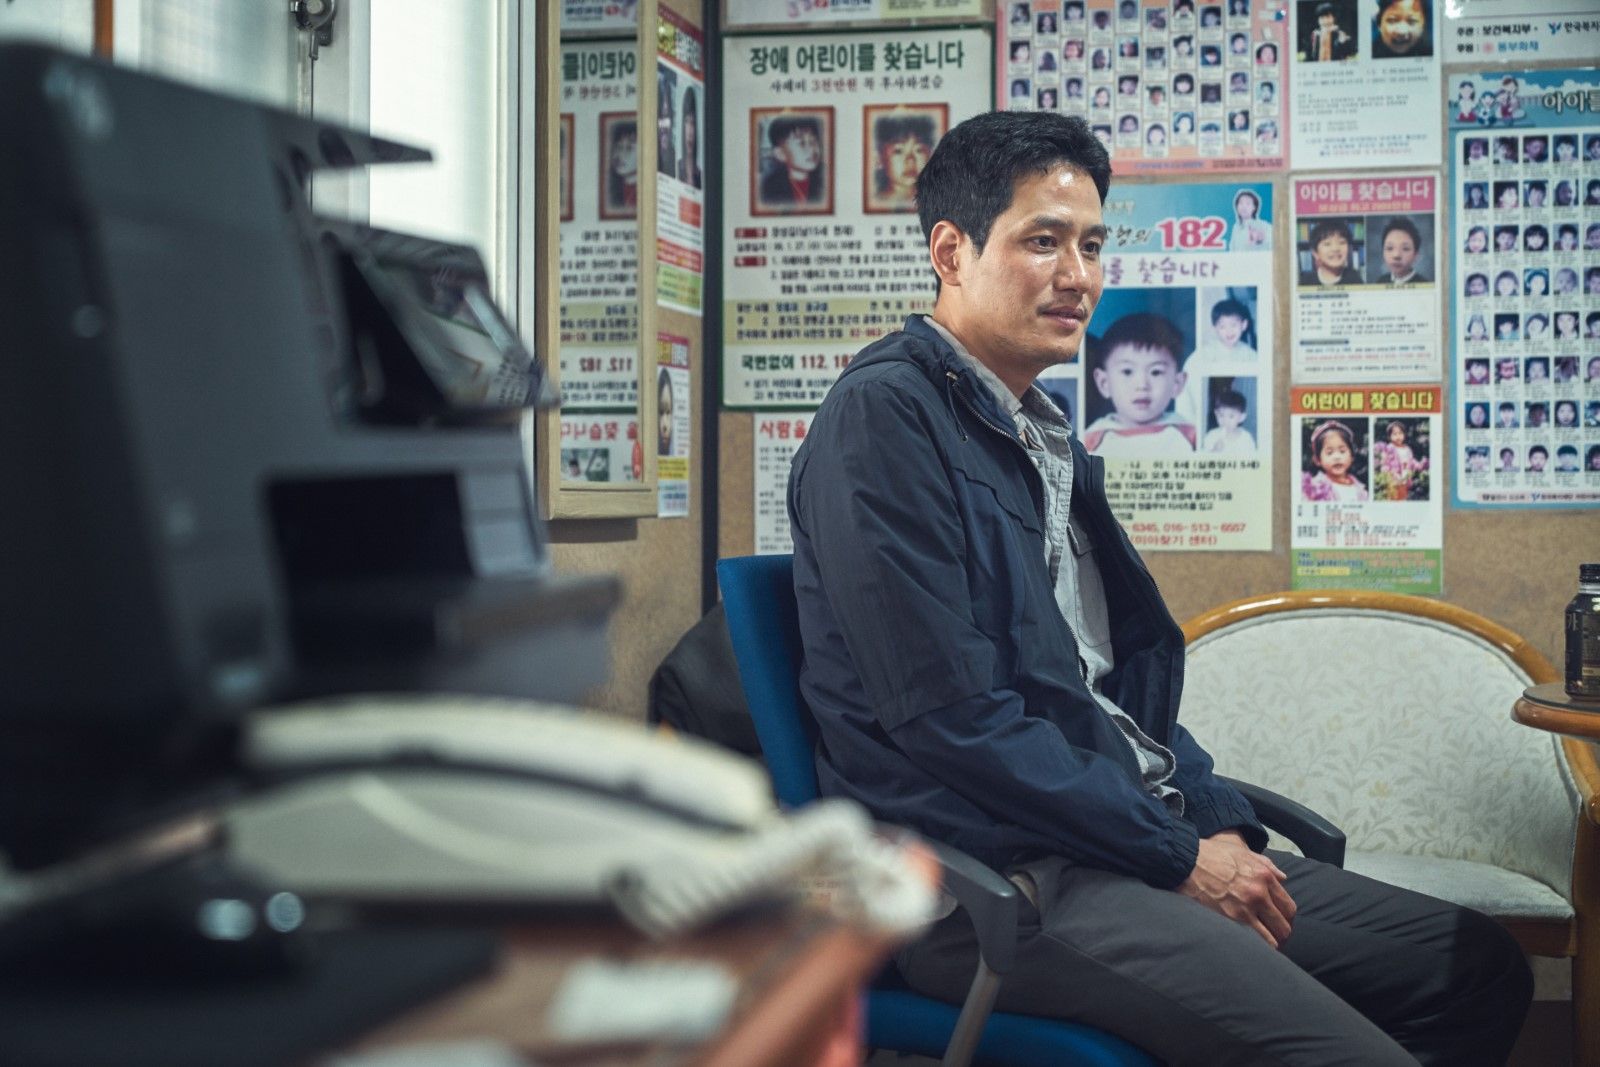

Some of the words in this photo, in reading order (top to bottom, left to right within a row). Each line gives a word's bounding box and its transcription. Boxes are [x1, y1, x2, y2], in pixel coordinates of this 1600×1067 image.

[1483, 24, 1531, 36] 보건복지부
[1564, 21, 1600, 33] 한국복지
[750, 46, 789, 75] 장애
[797, 43, 875, 73] 어린이를
[883, 40, 964, 70] 찾습니다
[1301, 183, 1353, 202] 아이를
[1359, 180, 1430, 201] 찾습니다
[1159, 218, 1226, 249] 182
[1103, 257, 1124, 284] 를
[1139, 257, 1221, 284] 찾습니다
[742, 355, 794, 371] 국번없이
[1302, 392, 1364, 410] 어린이를
[1370, 391, 1433, 410] 찾습니다
[760, 420, 806, 439] 사람을
